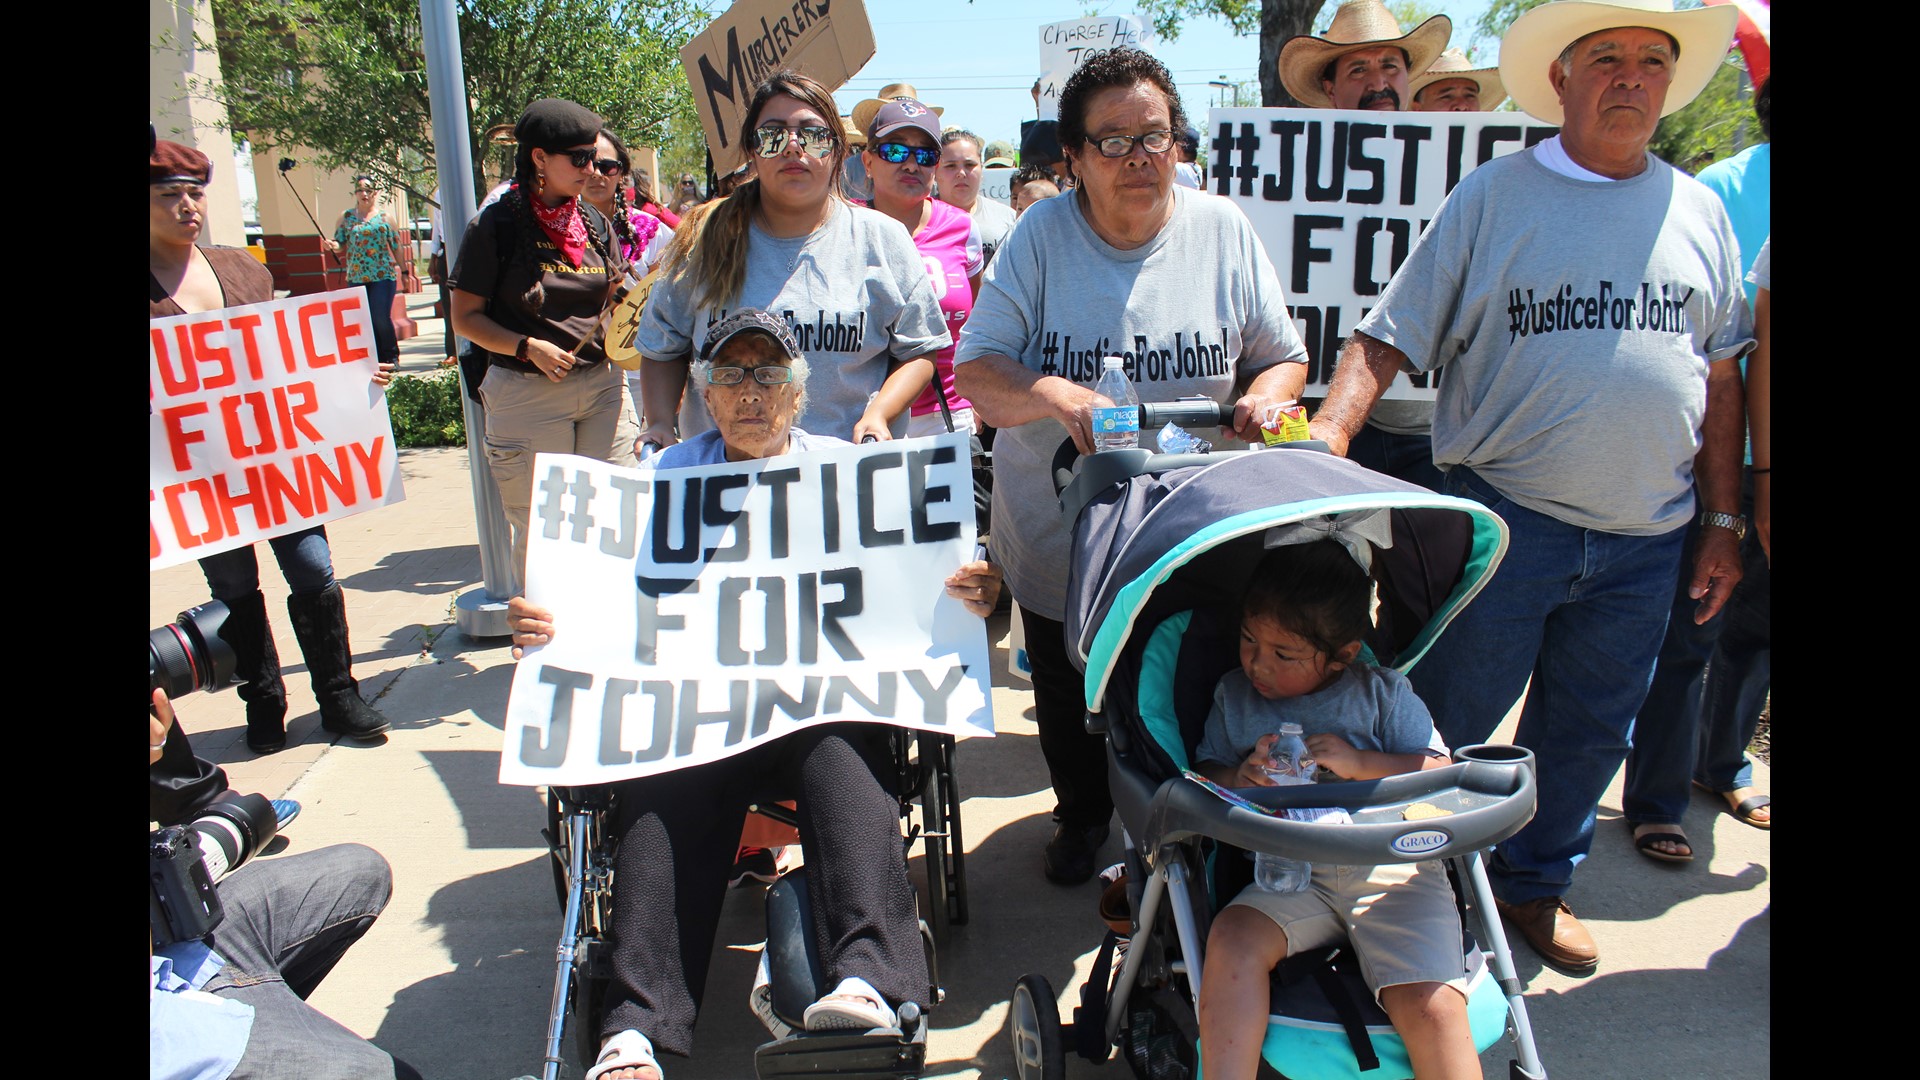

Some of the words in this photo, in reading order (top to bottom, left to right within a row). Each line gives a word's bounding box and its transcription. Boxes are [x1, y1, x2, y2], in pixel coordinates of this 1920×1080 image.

[1211, 119, 1561, 206] #JUSTI
[1291, 214, 1431, 296] FO
[150, 297, 369, 402] USTICE
[1041, 327, 1229, 383] #JusteForJohn!
[161, 380, 325, 472] FOR
[540, 446, 962, 564] #JUSTICE
[635, 567, 865, 665] FOR
[519, 664, 970, 768] JOHNNY
[1400, 835, 1444, 848] GRACO
